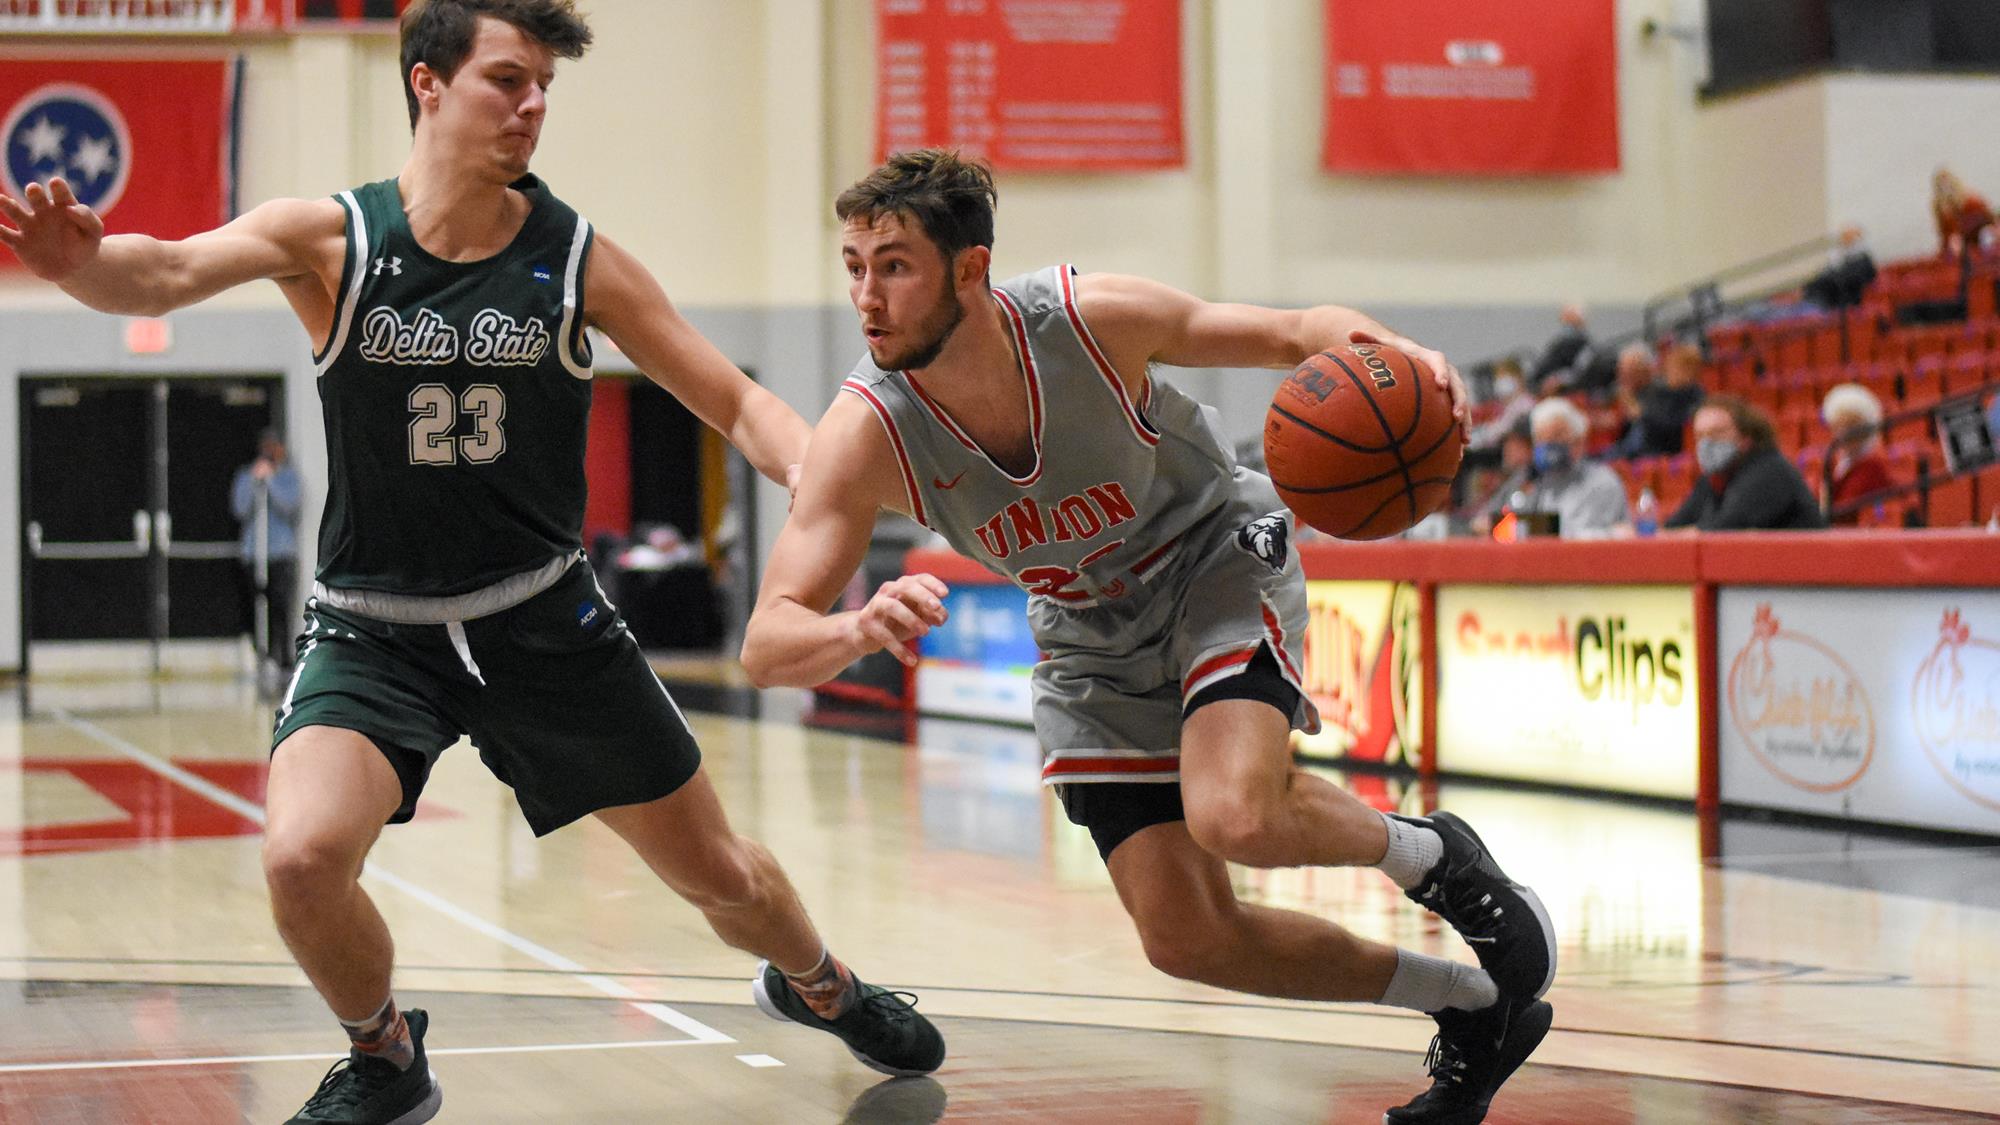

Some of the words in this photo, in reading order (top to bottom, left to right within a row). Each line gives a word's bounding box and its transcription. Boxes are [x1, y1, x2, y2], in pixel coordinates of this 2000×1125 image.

[360, 305, 459, 365] Delta
[464, 308, 550, 367] State
[1349, 344, 1397, 392] son
[408, 383, 507, 466] 23
[973, 481, 1138, 560] UNION
